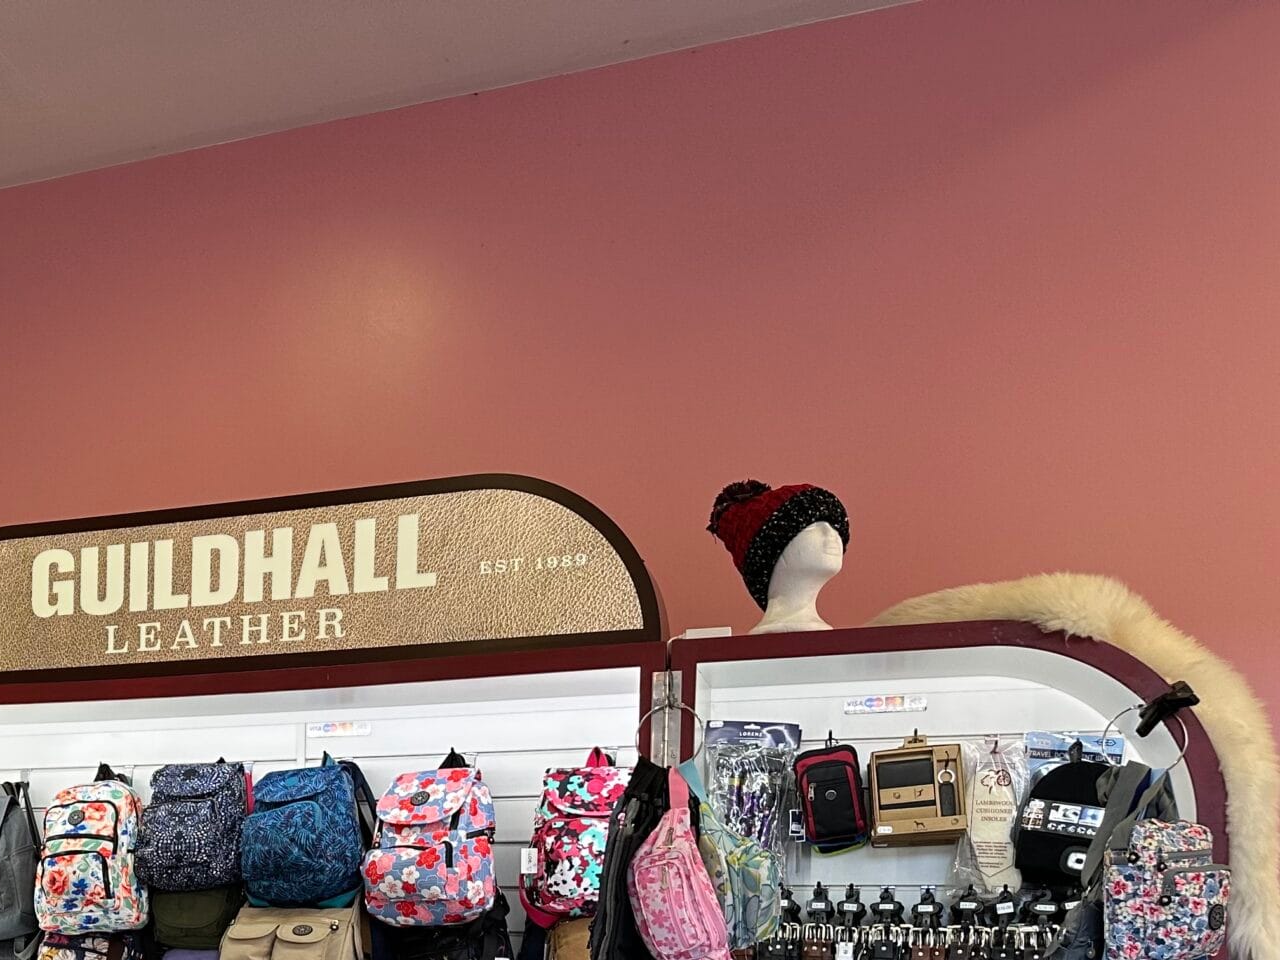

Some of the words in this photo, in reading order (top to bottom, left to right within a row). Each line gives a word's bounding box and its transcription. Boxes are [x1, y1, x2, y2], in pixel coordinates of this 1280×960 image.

[31, 513, 437, 618] GUILDHALL
[480, 558, 523, 574] EST
[535, 553, 588, 570] 1989
[105, 608, 346, 654] LEATHER
